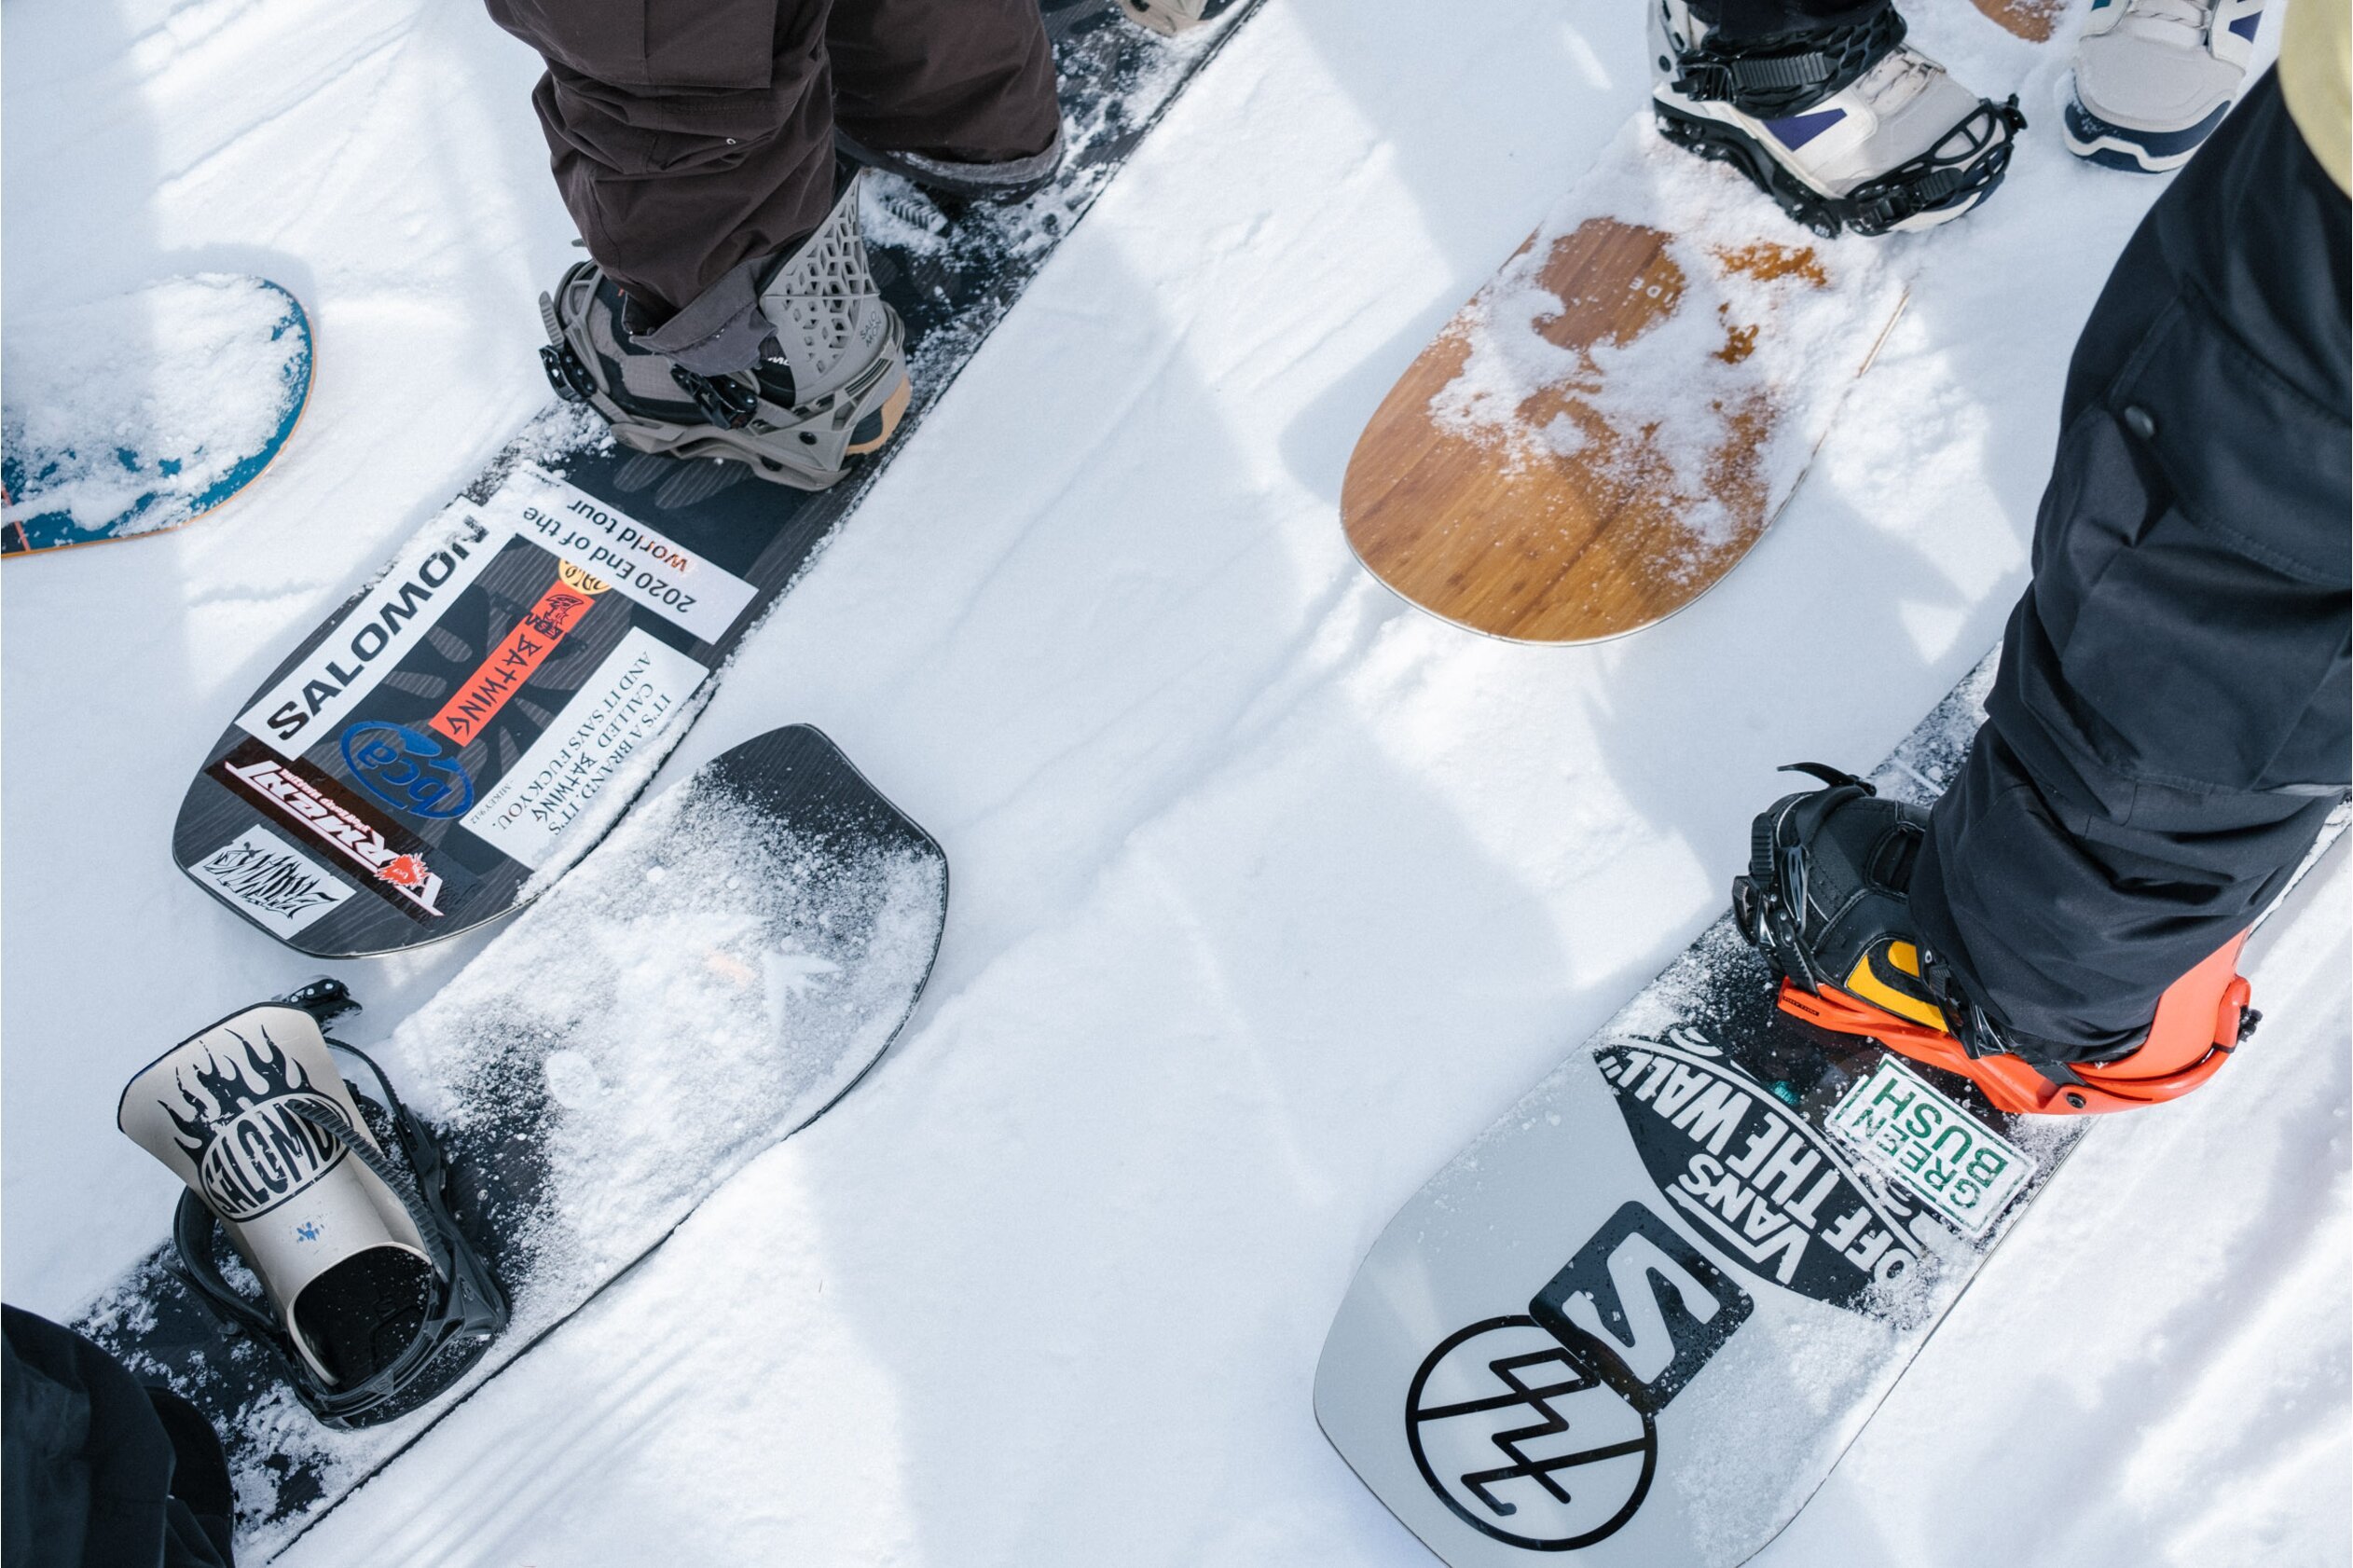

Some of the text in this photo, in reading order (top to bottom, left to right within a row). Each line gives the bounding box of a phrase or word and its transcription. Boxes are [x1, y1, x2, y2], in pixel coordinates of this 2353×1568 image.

[523, 507, 561, 536] the
[558, 531, 590, 550] of
[567, 500, 688, 572] world tour
[589, 545, 636, 580] End
[267, 515, 489, 740] SALOMON
[635, 571, 696, 612] 2020
[446, 633, 543, 736] BATWING
[640, 694, 671, 728] IT'S
[357, 739, 454, 811] bca
[492, 652, 652, 830] AND IT SAYS FUCK YOU.
[531, 683, 654, 822] CALLED BATWING
[628, 723, 642, 740] A
[548, 803, 580, 835] IT'S
[204, 1098, 341, 1214] SALOMO
[1725, 1111, 1840, 1230] THE
[1851, 1107, 1982, 1209] GREEN
[1872, 1077, 2008, 1189] BUSH
[1665, 1152, 1810, 1286] VANS
